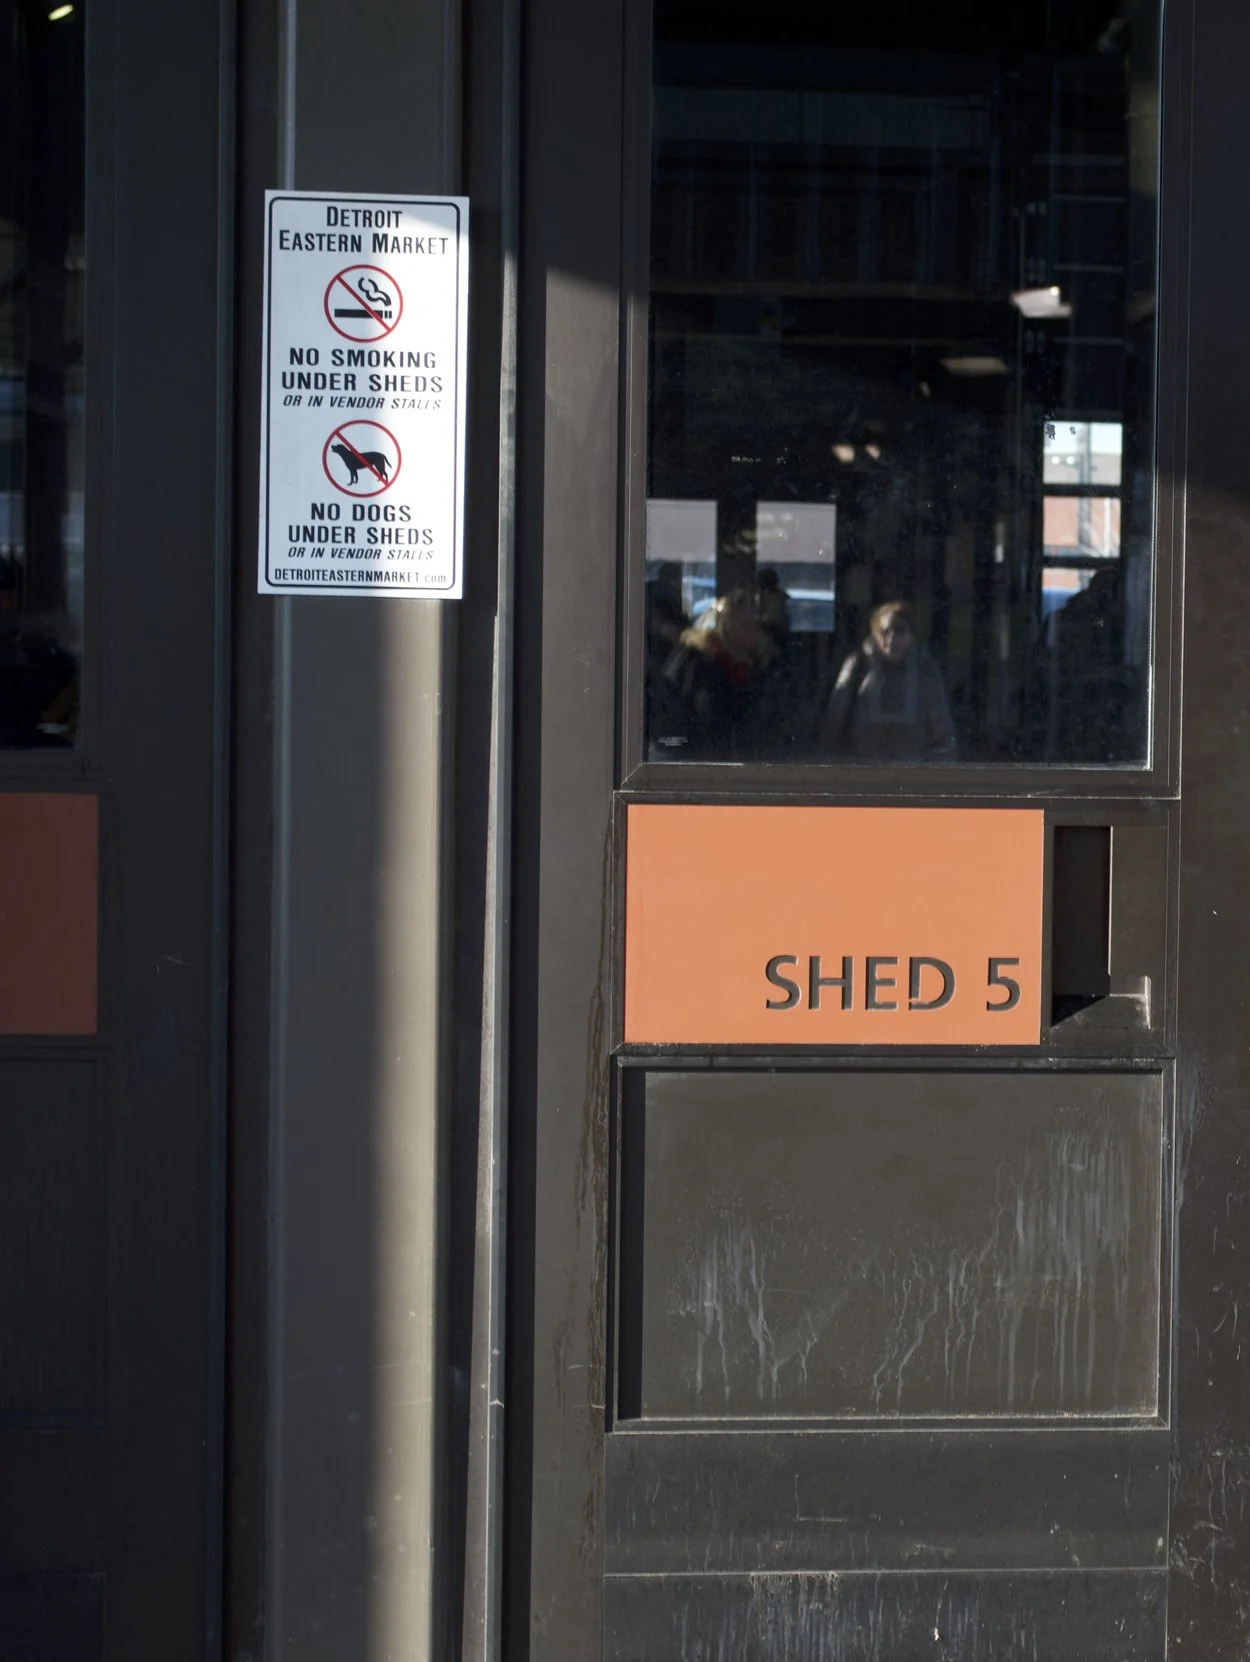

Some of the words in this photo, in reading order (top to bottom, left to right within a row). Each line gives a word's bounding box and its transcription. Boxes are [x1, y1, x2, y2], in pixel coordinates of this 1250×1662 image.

[326, 206, 403, 229] DETROIT
[279, 230, 362, 253] EASTERN
[372, 233, 449, 255] MARKET
[289, 348, 320, 366] NO
[331, 348, 436, 369] SMOKING
[281, 372, 357, 391] UNDER
[368, 373, 443, 393] SHEDS
[283, 395, 303, 407] OR
[308, 395, 321, 407] IN
[329, 396, 385, 409] VENDOR
[391, 398, 442, 410] STALLS
[310, 503, 341, 521] NO
[352, 503, 412, 522] DOGS
[288, 525, 356, 543] UNDER
[366, 526, 434, 545] SHEDS
[288, 547, 306, 558] OR
[310, 547, 324, 559] IN
[330, 548, 381, 560] VENDOR
[387, 549, 434, 560] STALLS
[274, 568, 447, 584] DETROITEASTERNMARKETcom
[765, 953, 956, 1011] SHED
[986, 957, 1021, 1012] 5
